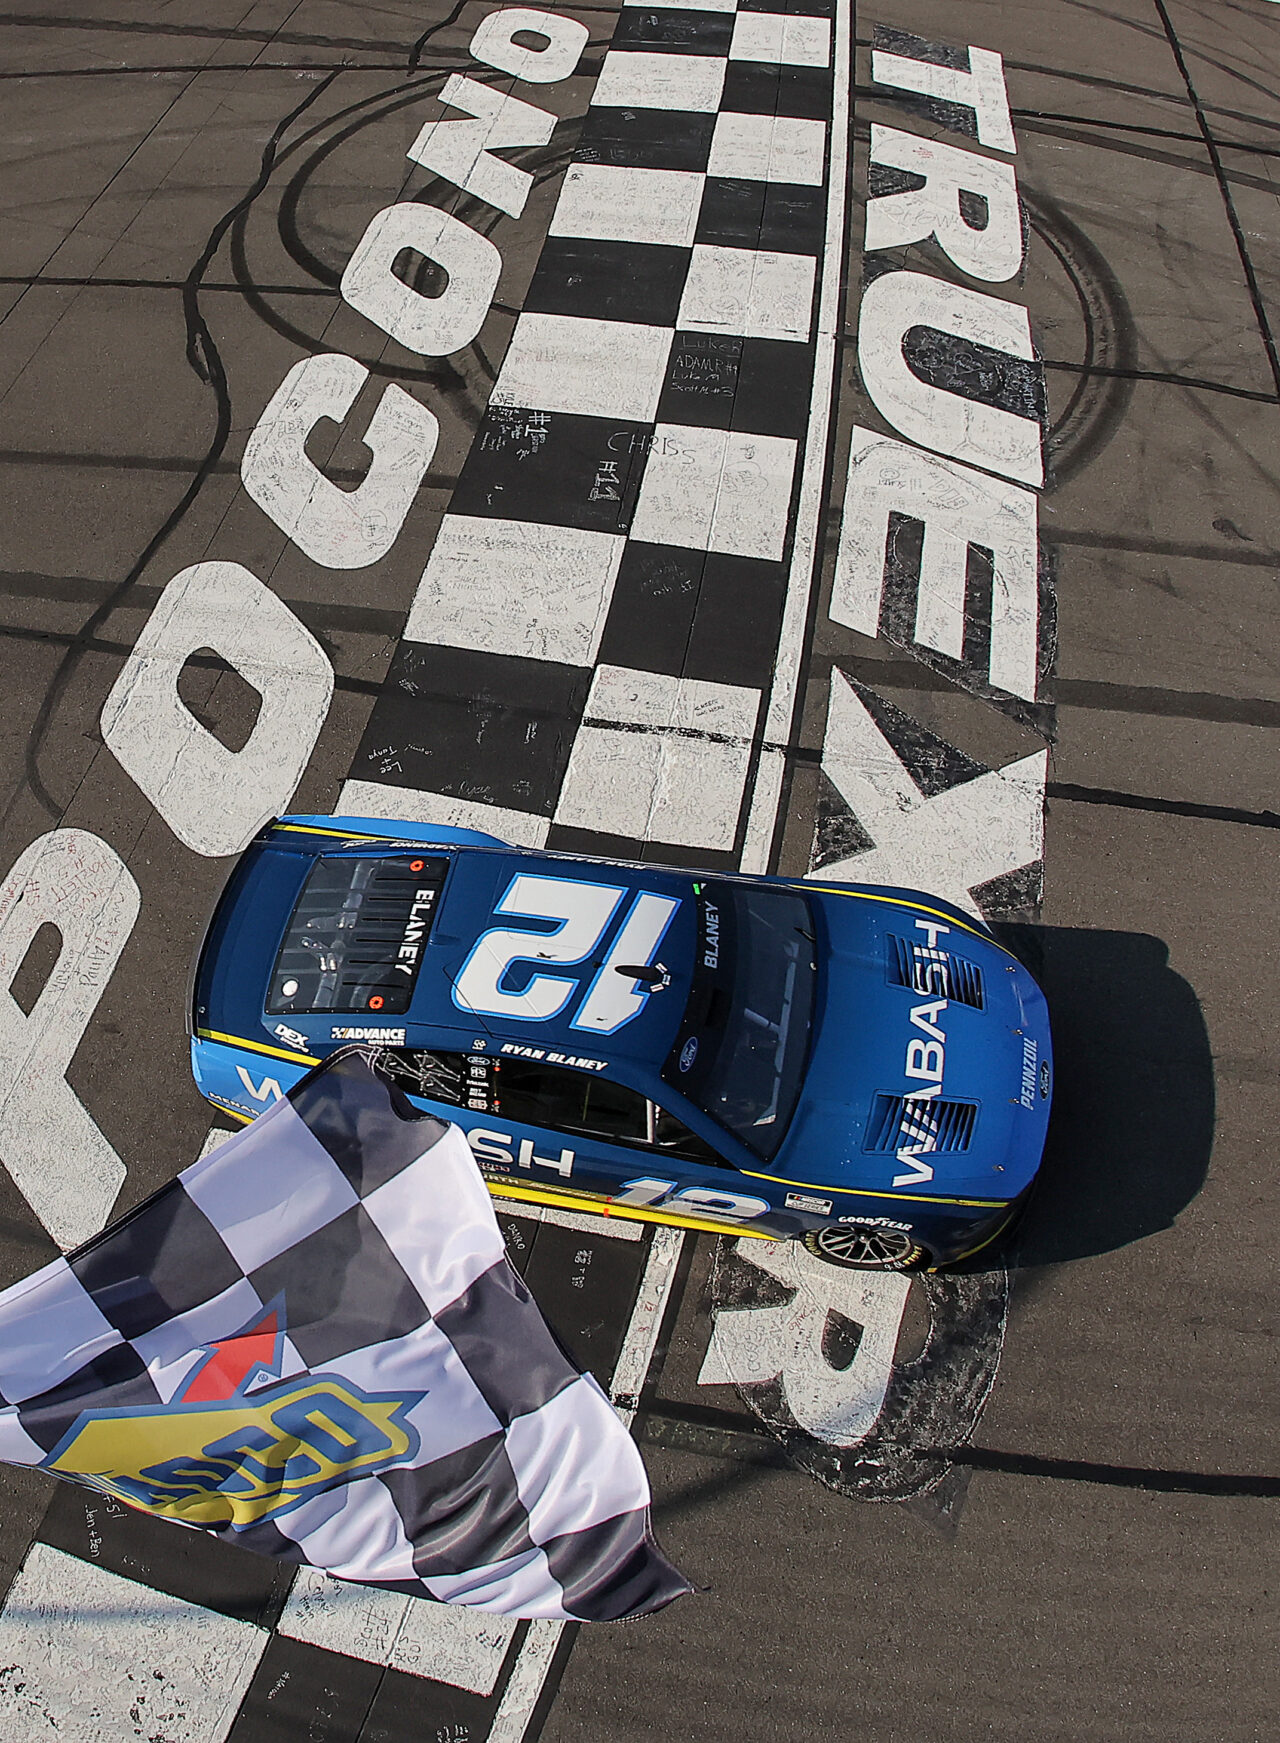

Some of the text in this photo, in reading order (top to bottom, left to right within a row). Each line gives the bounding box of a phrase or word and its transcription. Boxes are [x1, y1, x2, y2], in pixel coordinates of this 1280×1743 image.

[395, 889, 434, 976] BLANEY
[703, 900, 720, 970] BLANEY
[452, 872, 682, 1036] 12
[275, 1023, 310, 1047] DEX
[345, 1027, 406, 1041] ADVANCE
[385, 1039, 405, 1047] PARTS
[501, 1043, 545, 1060] RYAN
[546, 1051, 609, 1072] BLANEY
[891, 919, 951, 1187] WABASH
[1020, 1037, 1037, 1111] PENNZOIL
[838, 1216, 914, 1232] GOODYEAR
[89, 1536, 103, 1558] Ben
